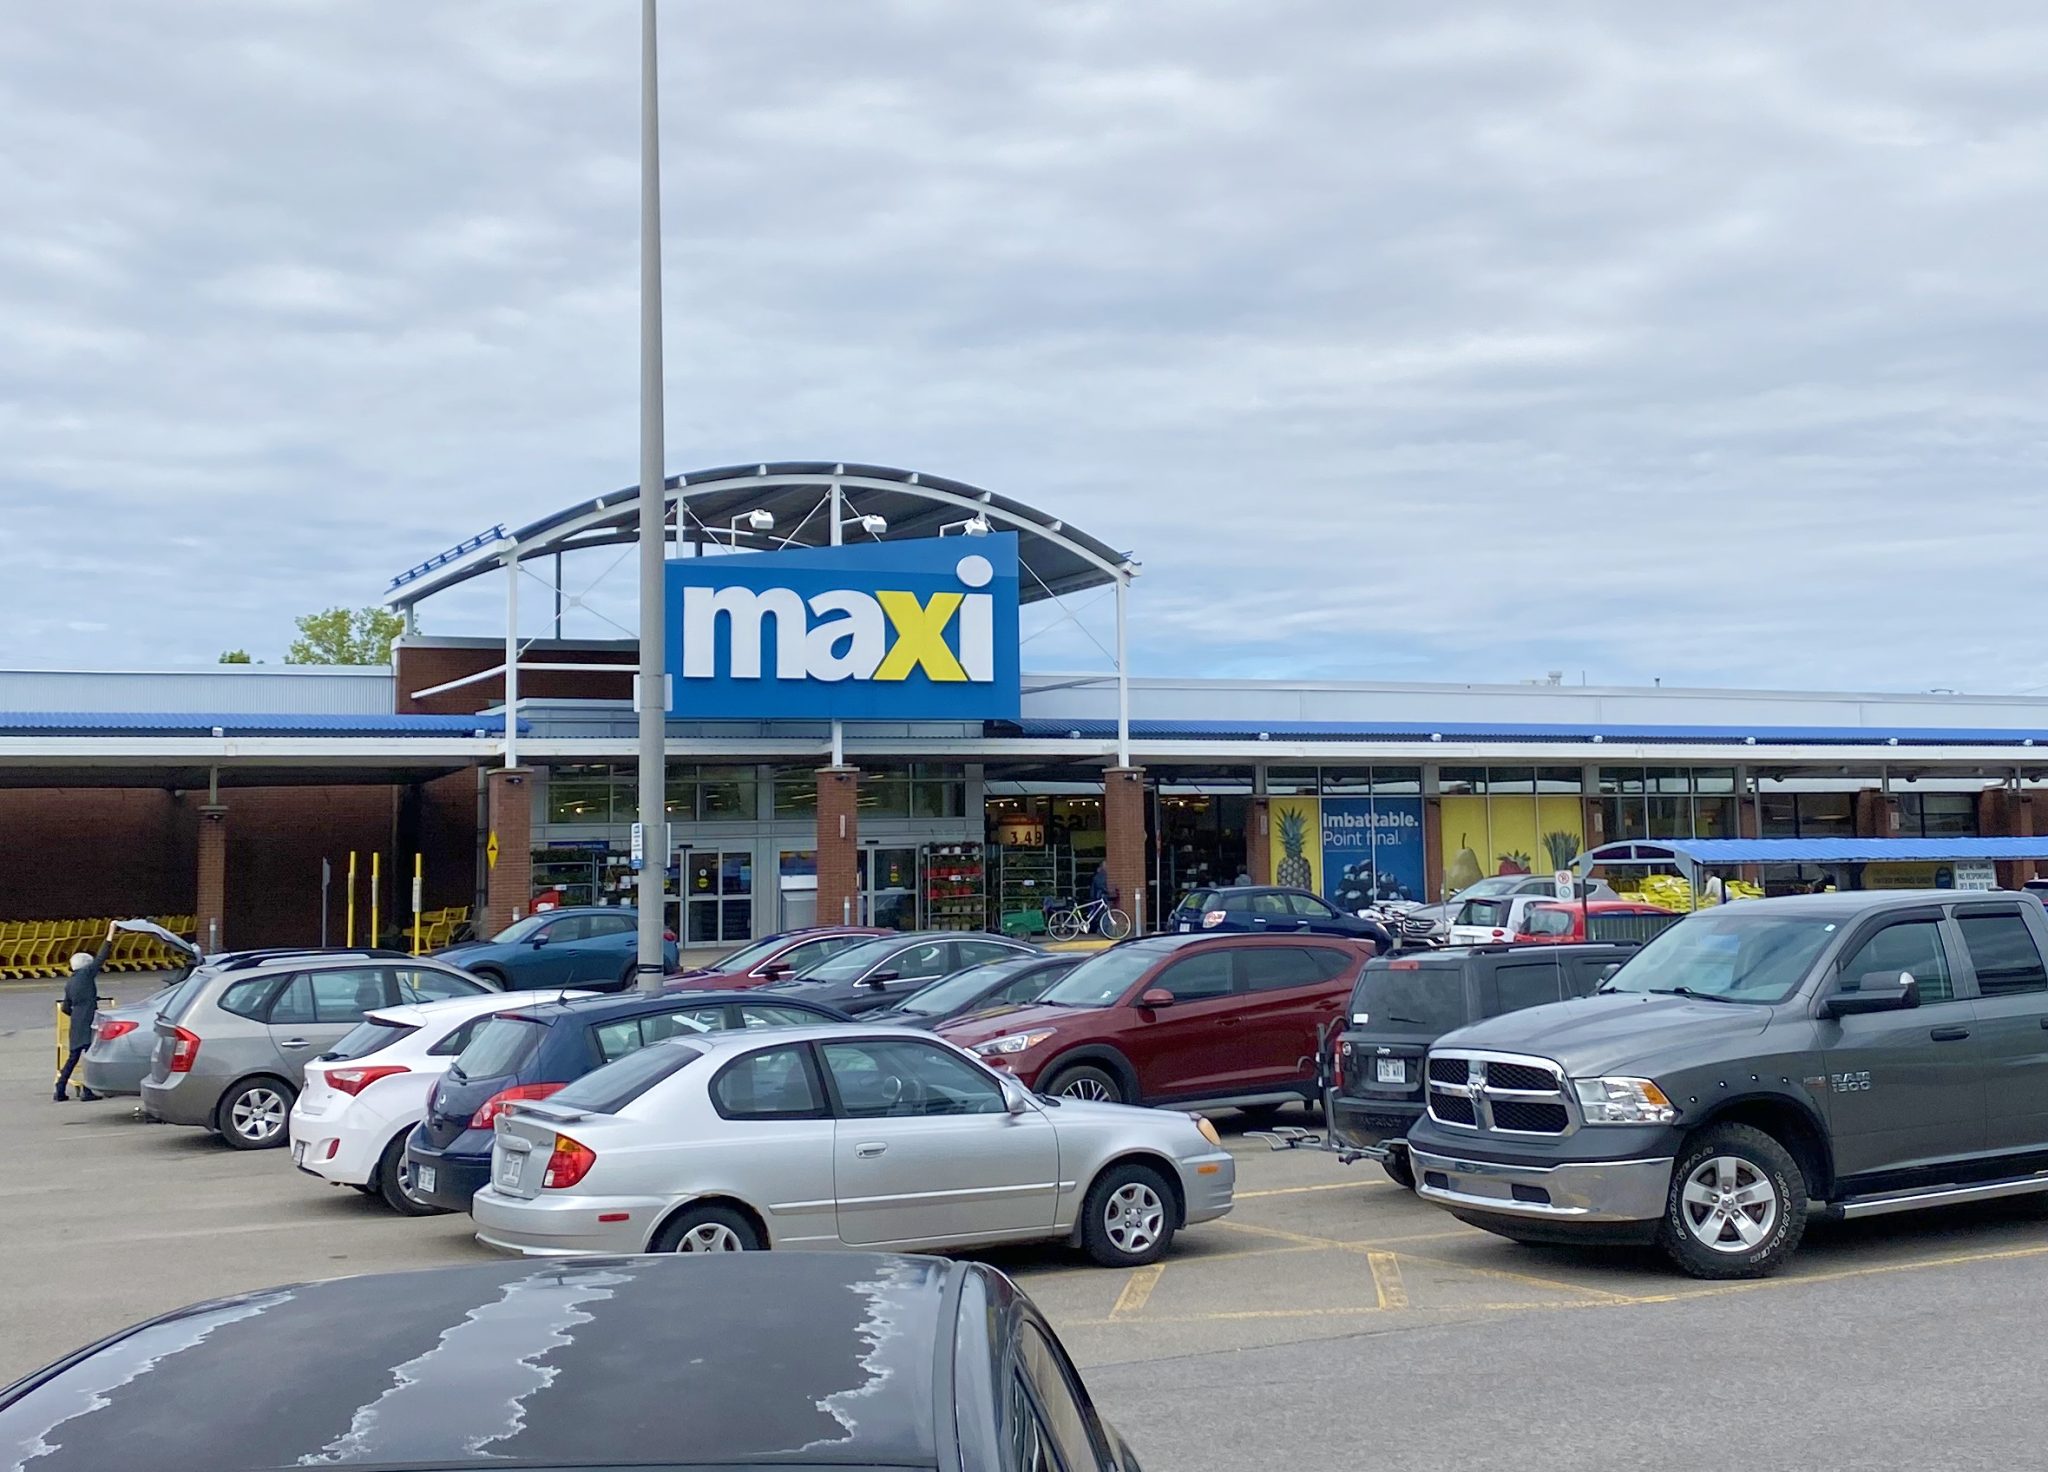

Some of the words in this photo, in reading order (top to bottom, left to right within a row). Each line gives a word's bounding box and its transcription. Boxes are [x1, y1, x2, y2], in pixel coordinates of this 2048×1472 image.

[683, 555, 994, 682] maxi
[1323, 811, 1419, 828] Imbattable.
[1323, 831, 1362, 846] Point
[1366, 829, 1402, 846] final.
[1831, 1070, 1871, 1083] RAM
[1831, 1081, 1871, 1093] 1500
[1750, 1171, 1792, 1263] WRANGLER
